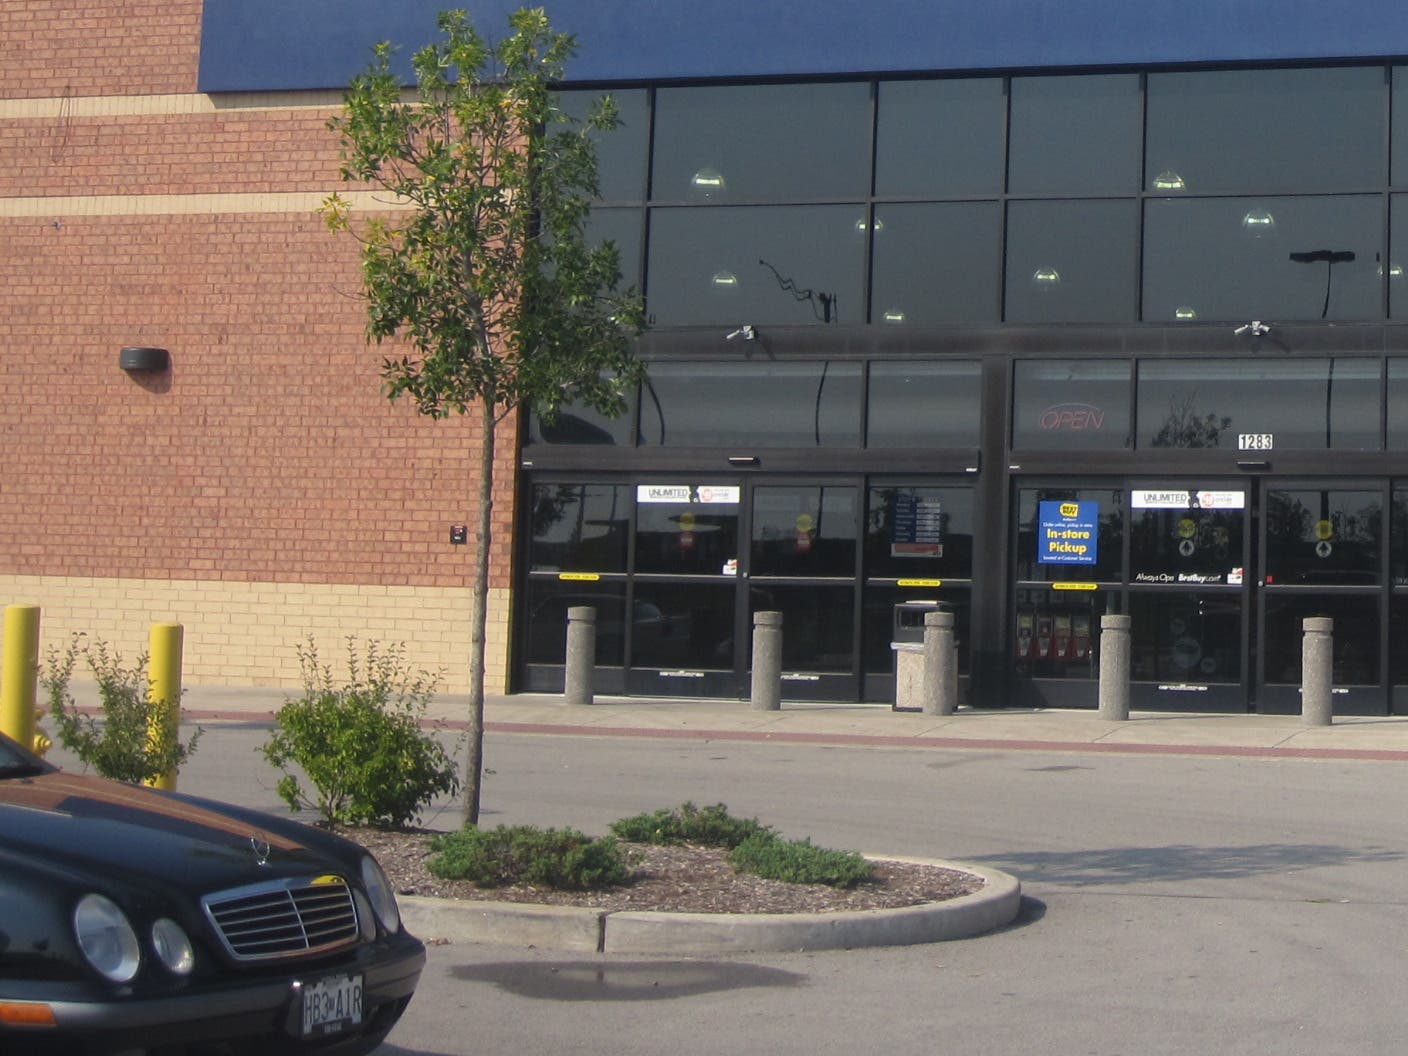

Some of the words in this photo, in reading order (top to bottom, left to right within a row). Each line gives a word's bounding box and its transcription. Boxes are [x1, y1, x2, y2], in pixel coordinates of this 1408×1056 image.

[1040, 410, 1104, 431] OPEN
[1240, 434, 1272, 449] 1283
[648, 488, 688, 498] UNLIMITED
[1143, 493, 1188, 502] UNLIMITED
[1047, 528, 1090, 539] In-store
[1049, 542, 1087, 556] Pickup
